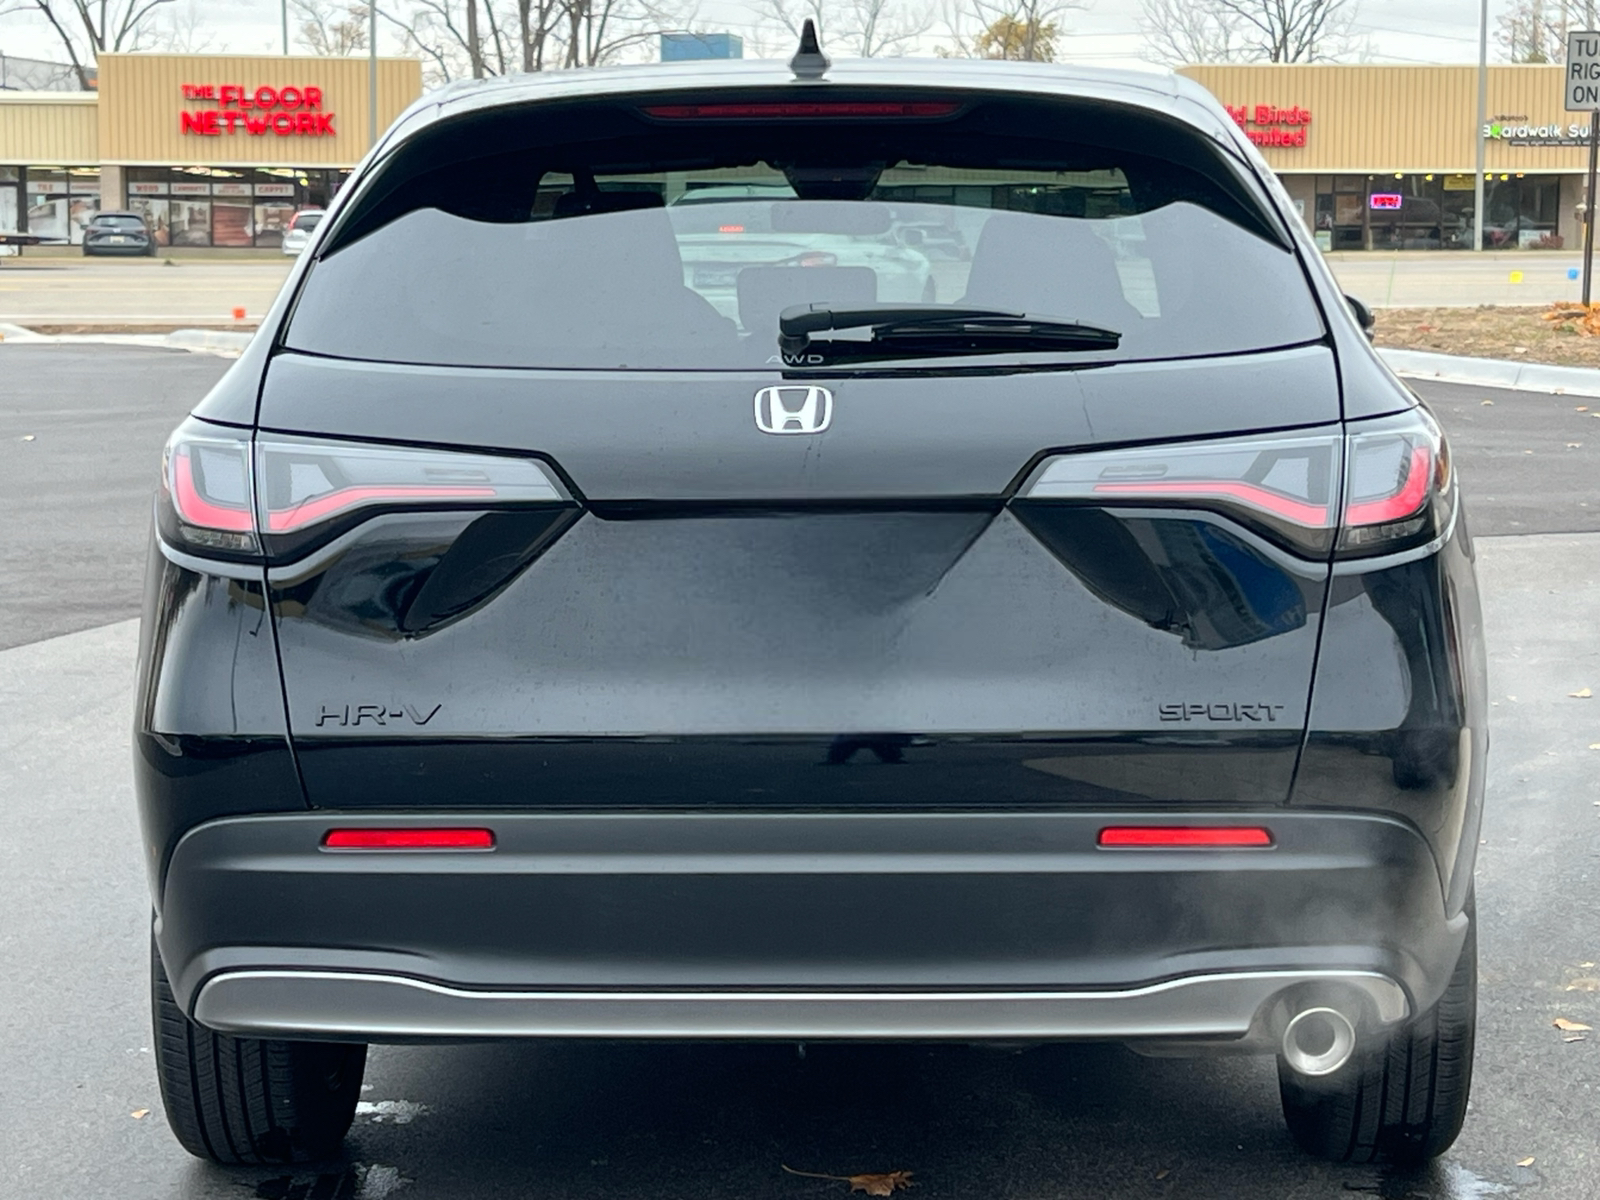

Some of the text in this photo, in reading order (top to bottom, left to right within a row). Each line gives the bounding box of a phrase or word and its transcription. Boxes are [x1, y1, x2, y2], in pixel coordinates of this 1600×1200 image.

[1575, 39, 1600, 57] TU
[181, 85, 323, 110] THE FLOOR
[1573, 85, 1598, 103] ON
[180, 110, 337, 136] NETWORK
[1255, 104, 1312, 126] Birds
[1246, 126, 1307, 147] mited
[1483, 124, 1593, 139] Boardwalk Su
[765, 354, 825, 364] AWD
[315, 704, 442, 726] HR-V
[1159, 702, 1285, 721] SPORT
